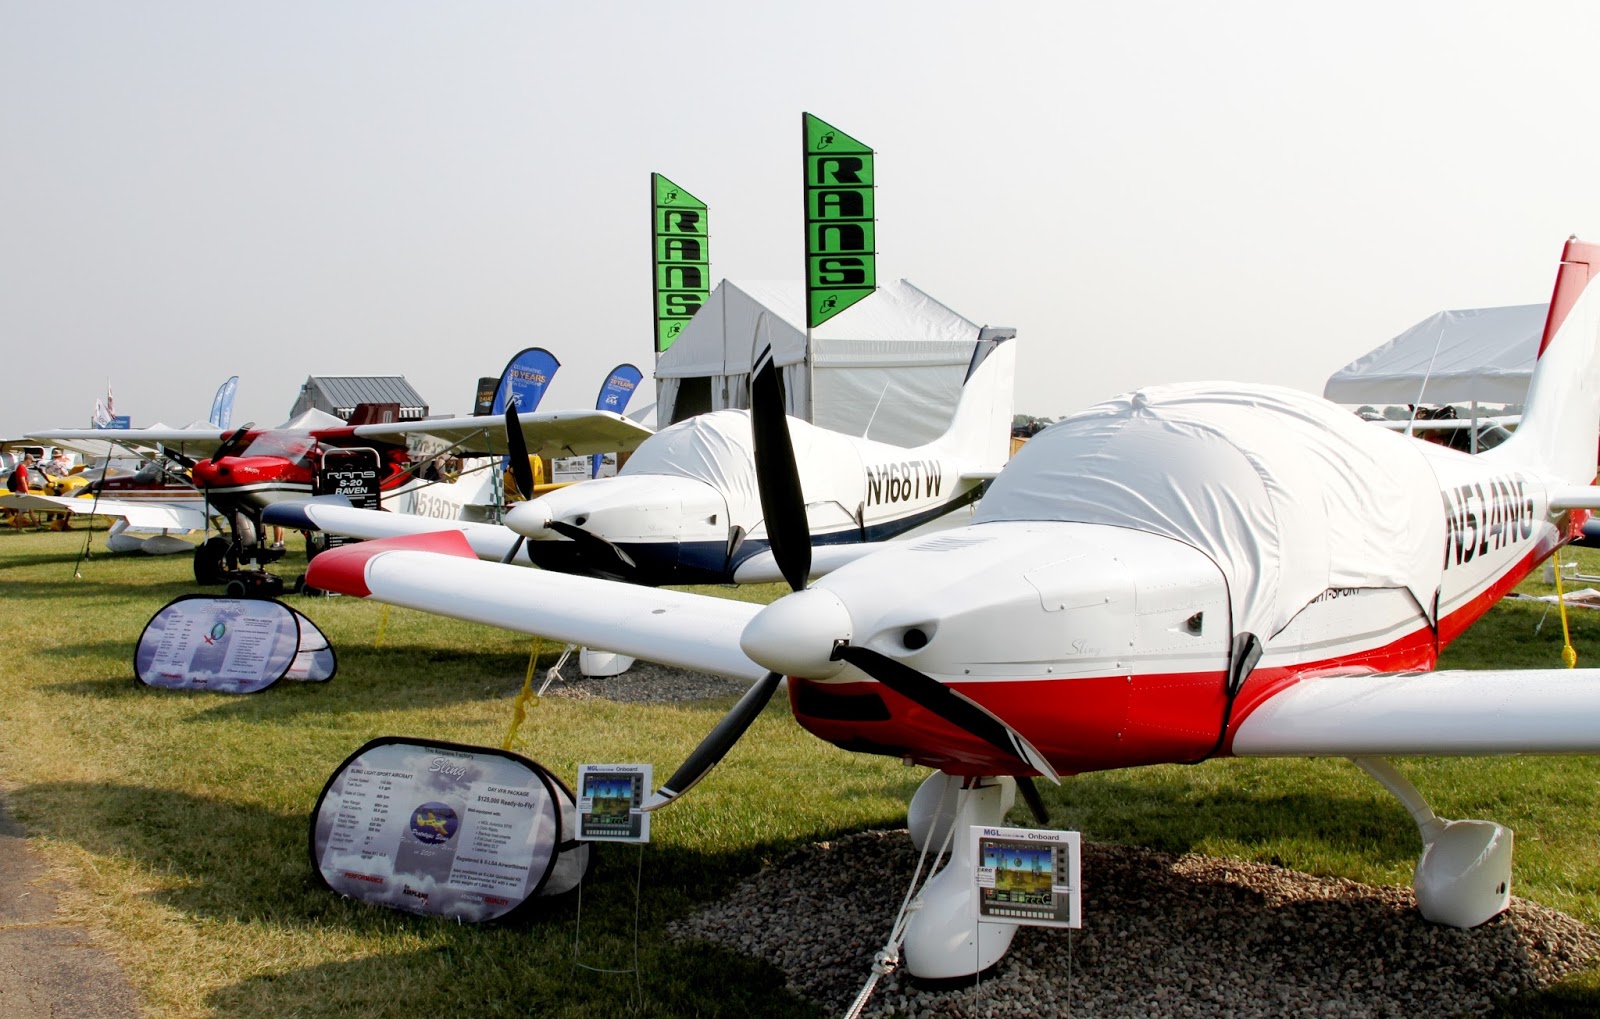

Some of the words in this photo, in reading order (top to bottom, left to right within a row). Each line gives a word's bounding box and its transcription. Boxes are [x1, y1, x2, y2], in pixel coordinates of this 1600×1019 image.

[817, 157, 865, 285] RANS
[664, 210, 702, 316] RANS
[520, 371, 547, 383] YEARS
[327, 471, 375, 479] RANS
[339, 479, 363, 487] S-20
[866, 460, 941, 506] N168TW
[335, 486, 368, 495] RAVEN
[406, 491, 460, 520] N513DT
[1441, 472, 1533, 571] N514NG
[456, 752, 474, 760] Factory
[428, 758, 466, 781] Sling
[500, 800, 535, 809] Ready-to-Fly!
